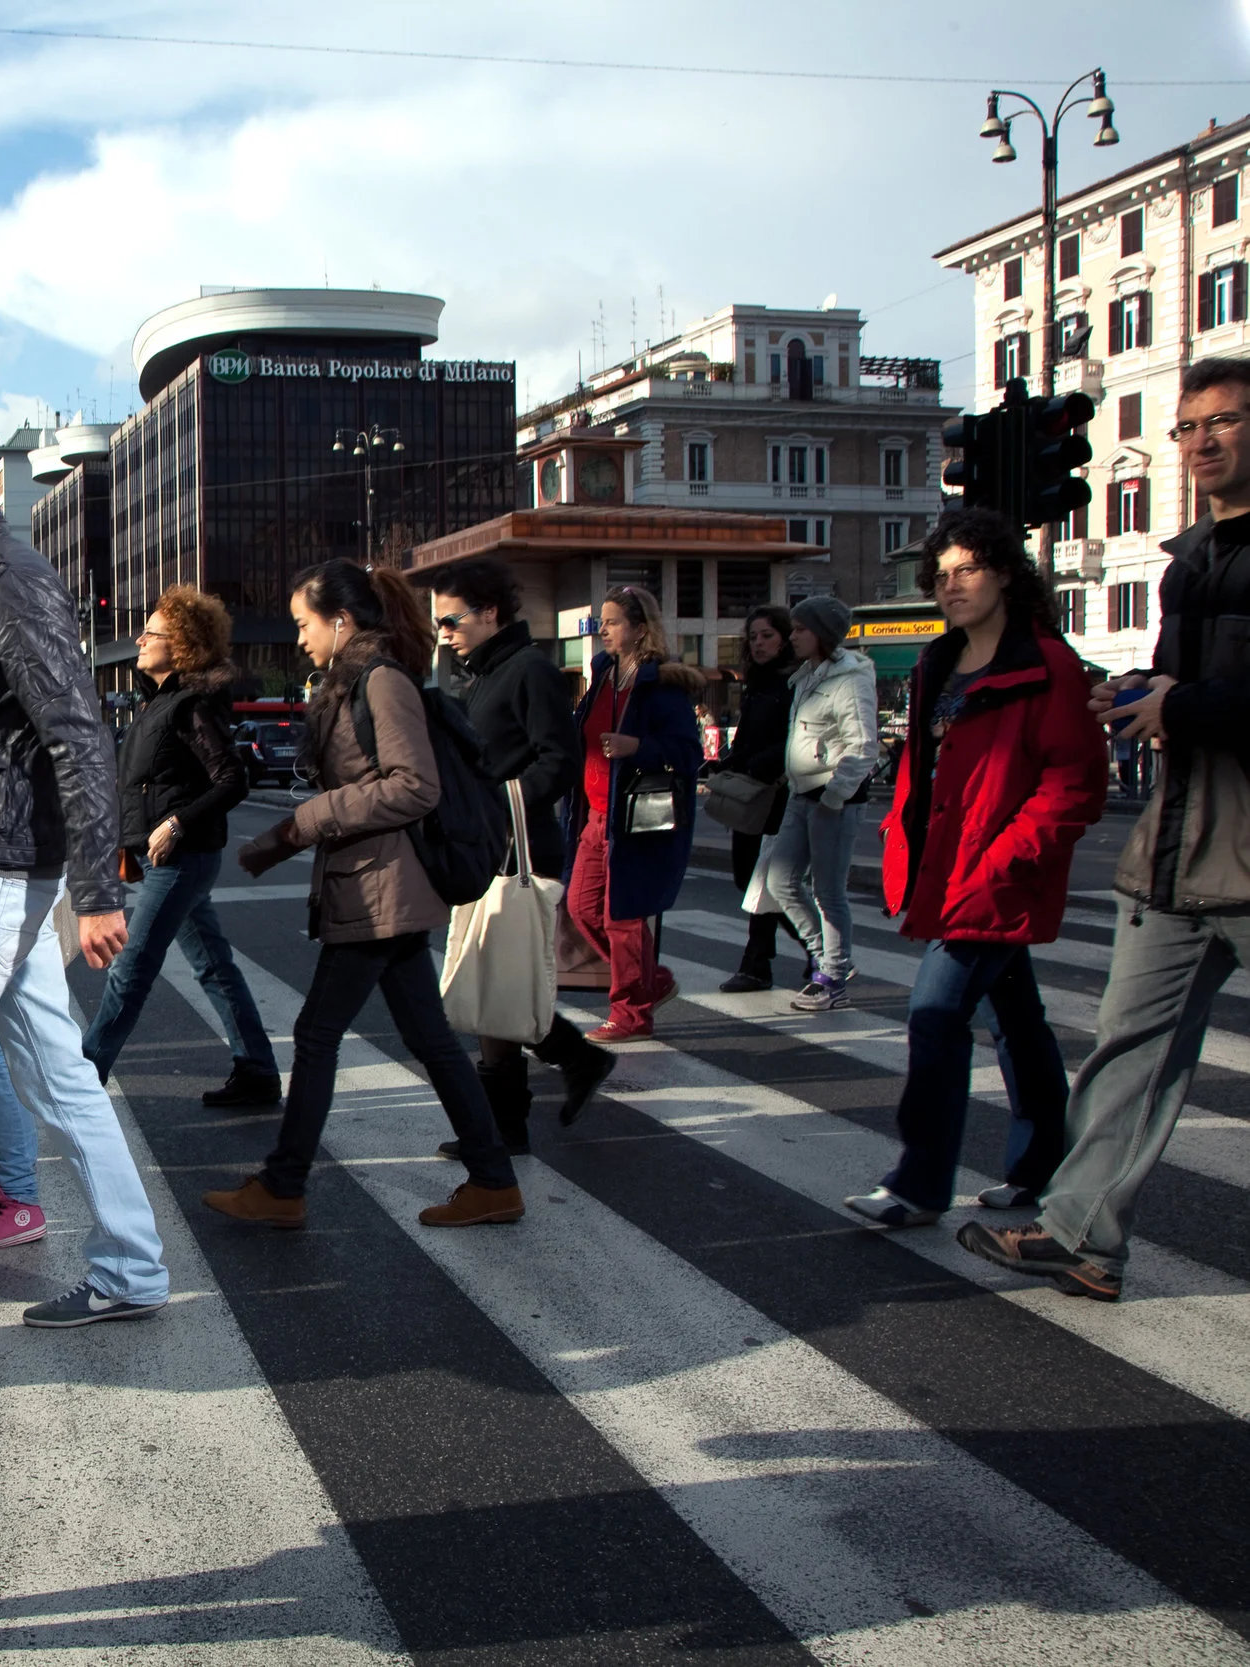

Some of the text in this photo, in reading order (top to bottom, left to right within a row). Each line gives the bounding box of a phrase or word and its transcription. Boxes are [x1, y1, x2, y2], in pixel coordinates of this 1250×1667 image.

[213, 357, 512, 382] BPM Banca Popolare di Milano
[871, 626, 902, 635] Corriere
[913, 623, 935, 634] Sport
